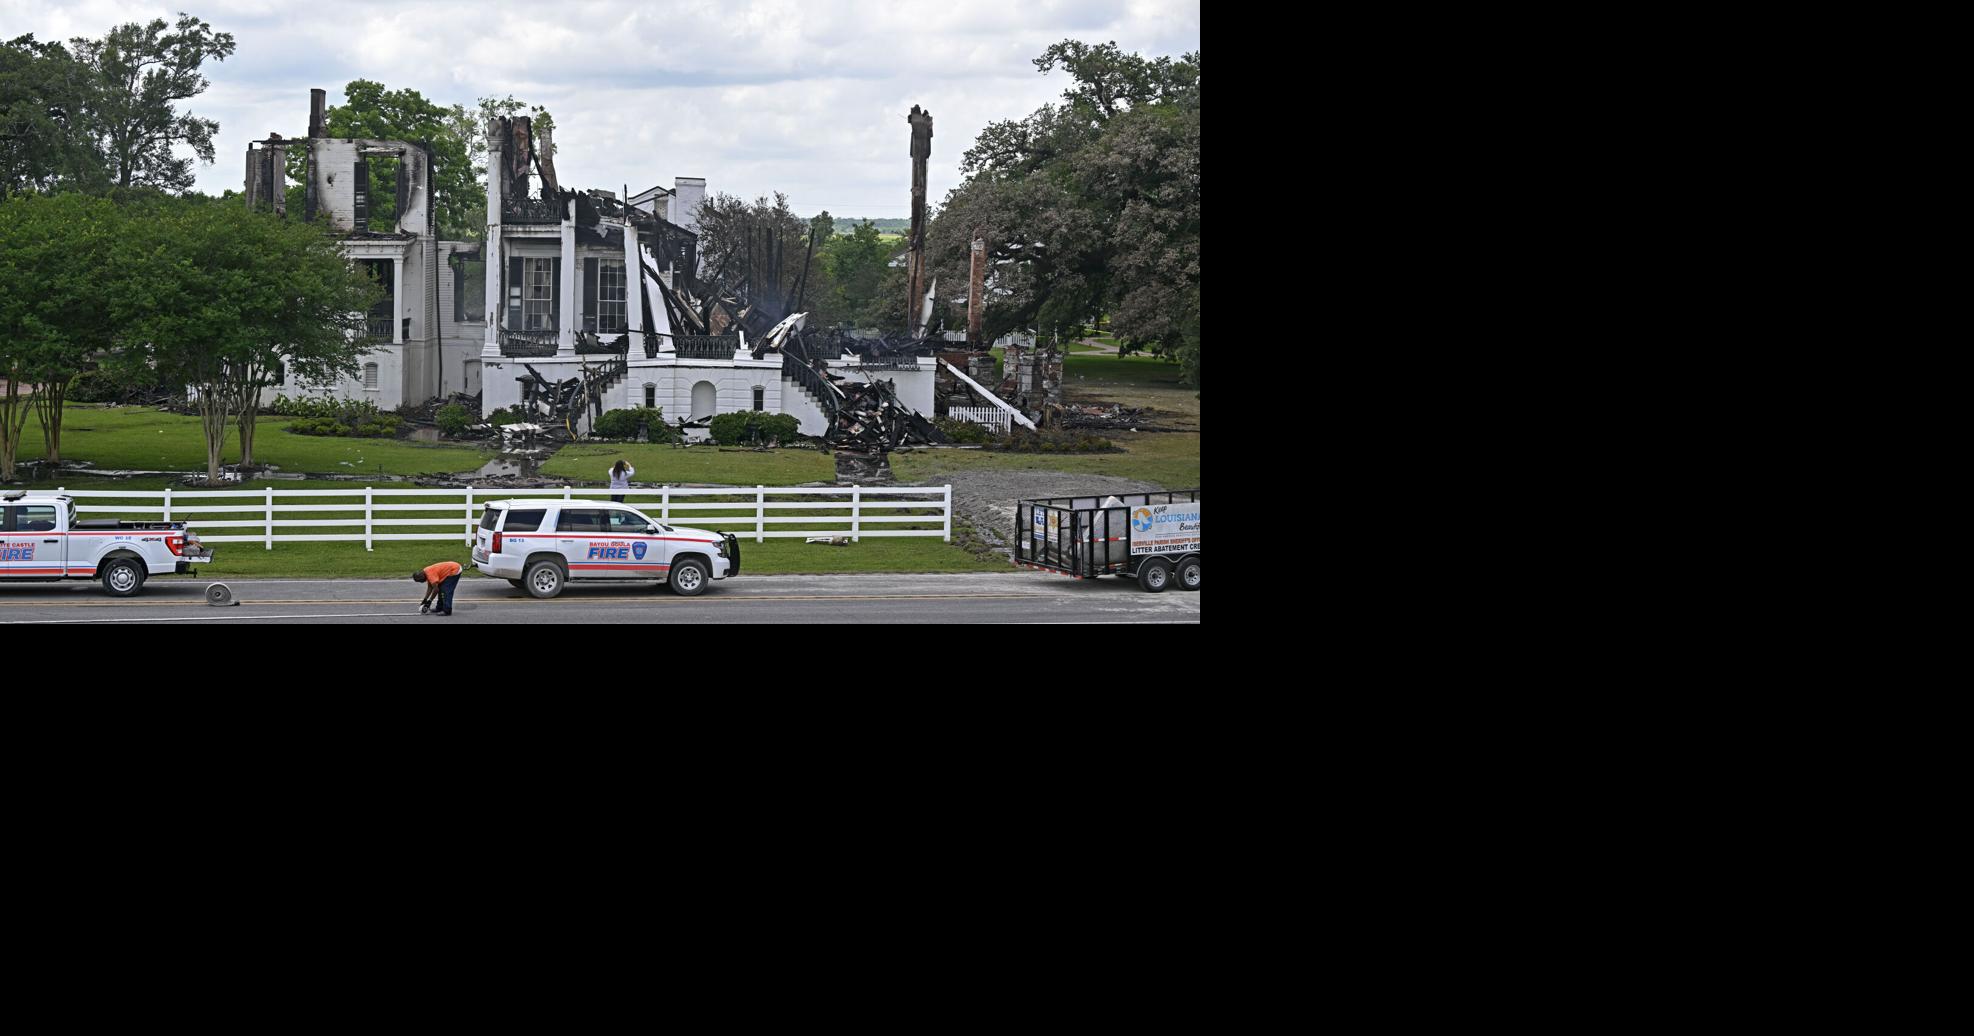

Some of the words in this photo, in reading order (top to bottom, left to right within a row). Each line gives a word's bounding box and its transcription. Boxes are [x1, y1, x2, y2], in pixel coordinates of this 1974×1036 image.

[0, 547, 33, 561] IRE
[587, 546, 630, 560] FIRE
[1132, 546, 1153, 554] LITTER
[1153, 544, 1188, 553] ABATEMENT
